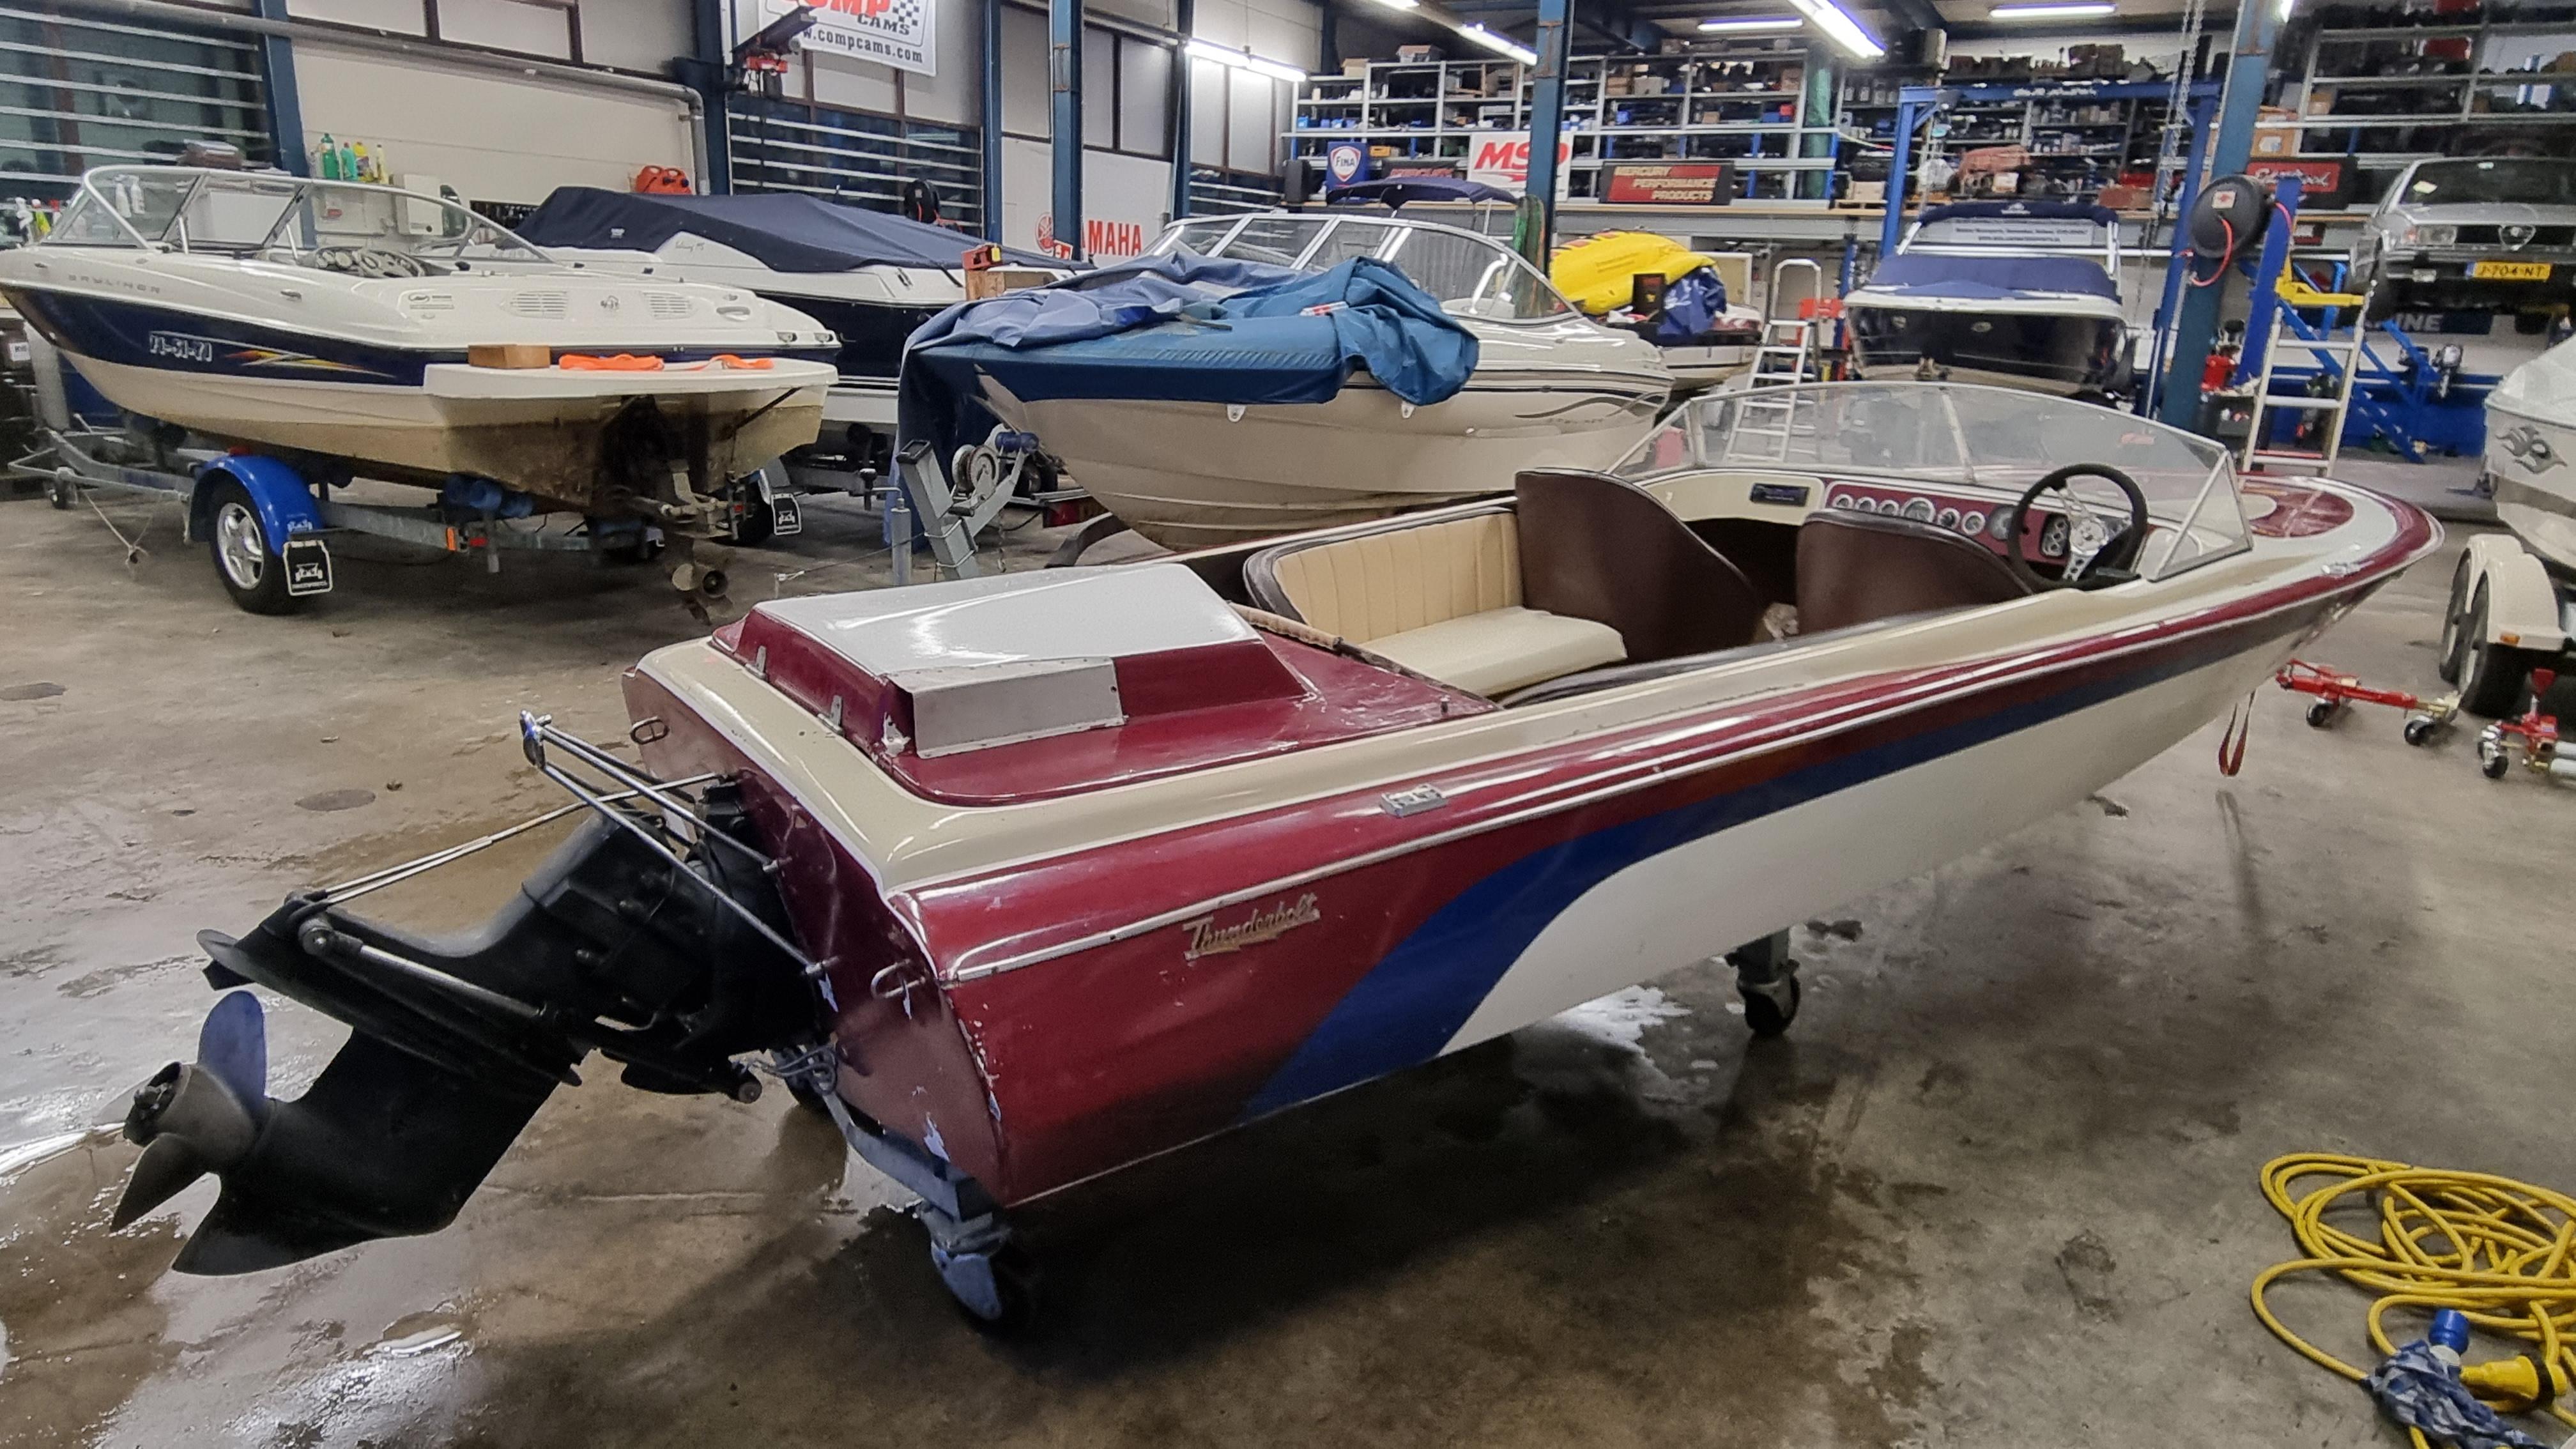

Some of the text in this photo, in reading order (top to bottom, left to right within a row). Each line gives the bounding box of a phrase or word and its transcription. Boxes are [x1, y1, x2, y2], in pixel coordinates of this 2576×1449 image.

[857, 13, 910, 36] CAMS
[802, 27, 923, 64] w.compcams.com
[1633, 178, 1717, 188] PERFORMANCE
[1652, 190, 1714, 201] PRODUCTS
[1082, 220, 1142, 256] MAHA
